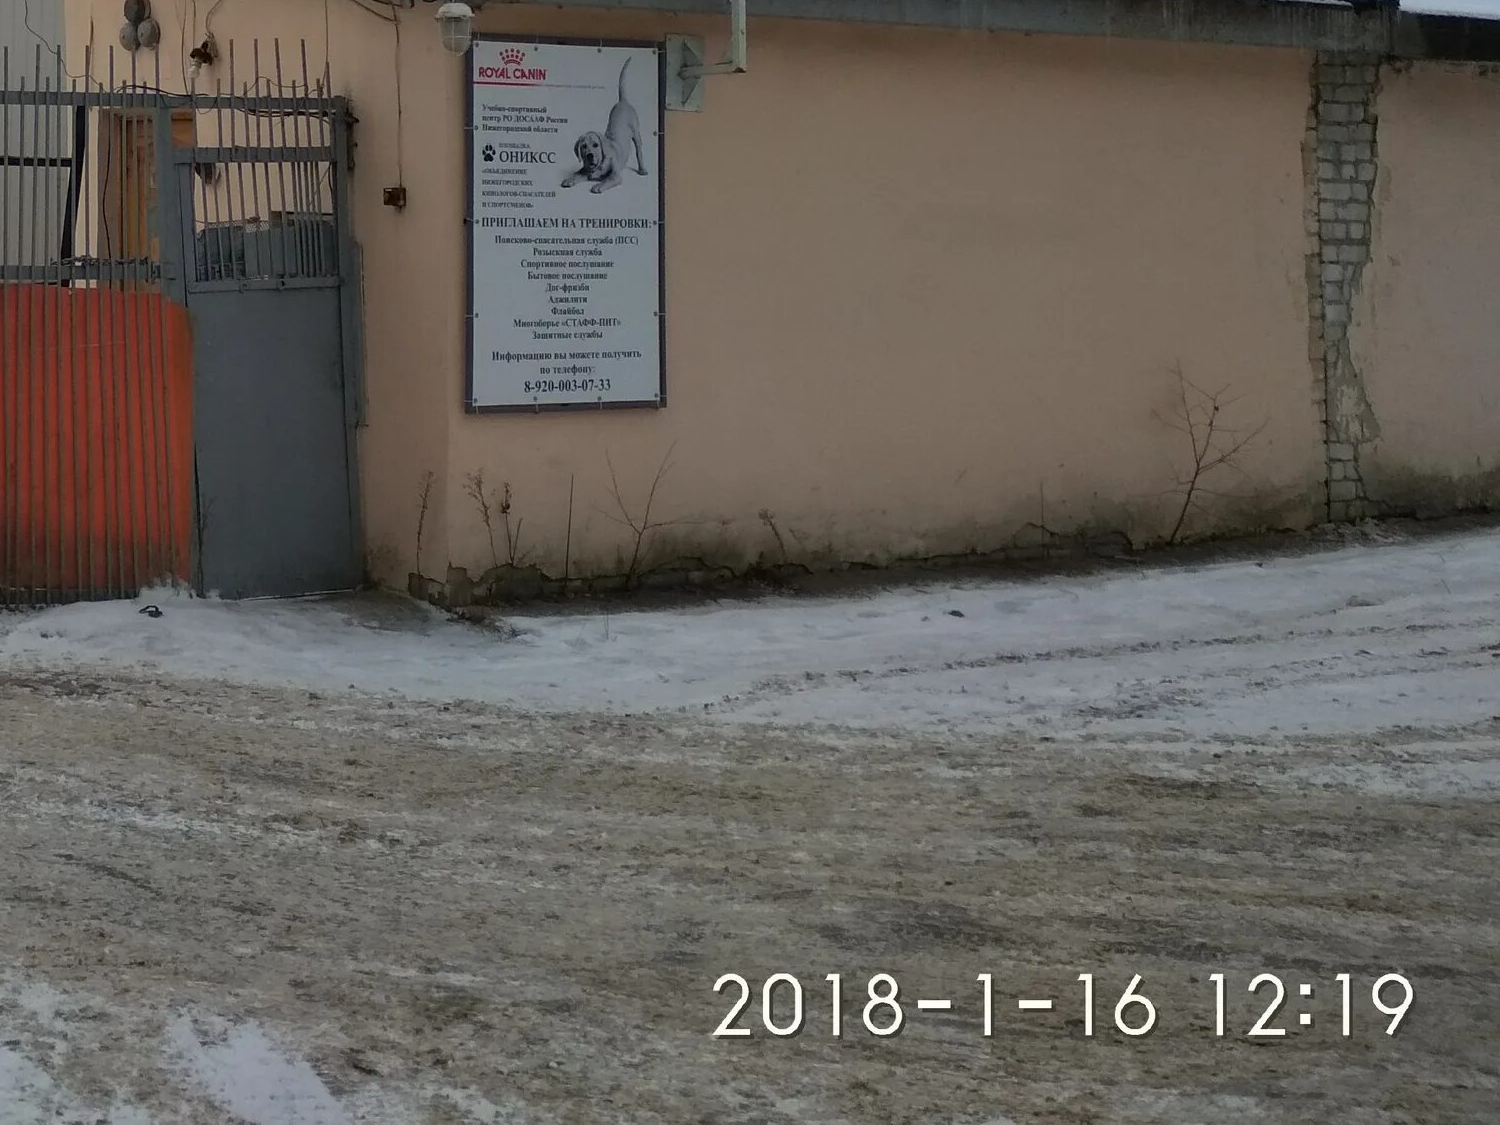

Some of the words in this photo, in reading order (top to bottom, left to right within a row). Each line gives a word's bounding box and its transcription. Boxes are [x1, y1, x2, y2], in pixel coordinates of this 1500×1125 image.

[478, 66, 511, 79] ROYAL
[513, 68, 547, 81] CANIN
[499, 150, 556, 164] ОНИКСС
[482, 217, 558, 228] ПРИГЛАШАЕМ
[561, 218, 576, 228] НА
[579, 218, 652, 229] ТРЕНИРОВКИ:
[495, 235, 585, 245] Поисково-спасательная
[587, 236, 613, 247] служба
[615, 235, 639, 246] (ПСС)
[533, 247, 574, 257] Розыскная
[576, 248, 602, 259] служба
[521, 259, 567, 270] Спортивное
[569, 260, 614, 271] послушание
[528, 271, 560, 280] Бытовое
[562, 272, 607, 282] послушание
[551, 306, 585, 316] Флайбол
[492, 350, 552, 363] Информацию
[554, 352, 567, 361] вы
[569, 352, 600, 361] можете
[602, 350, 642, 362] получить
[540, 366, 551, 375] по
[524, 378, 611, 394] 8-920-003-07-33
